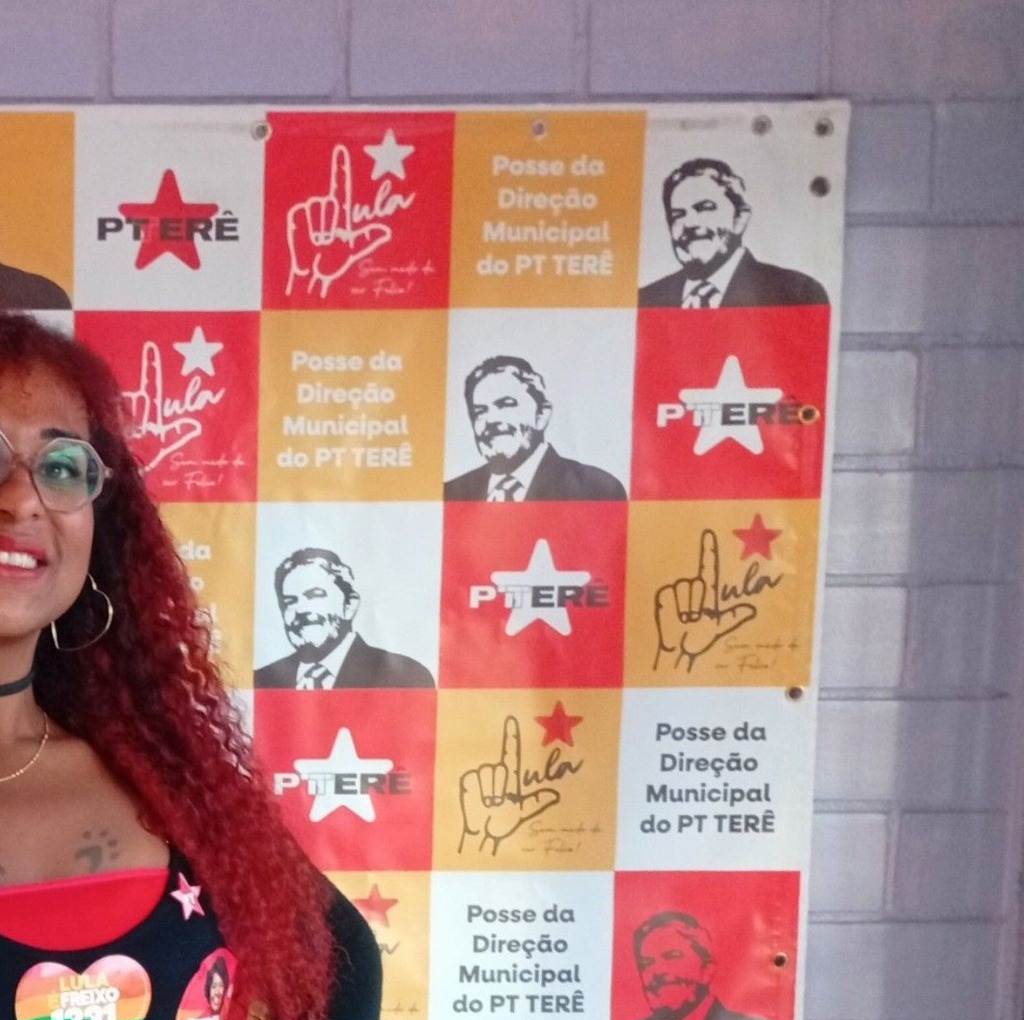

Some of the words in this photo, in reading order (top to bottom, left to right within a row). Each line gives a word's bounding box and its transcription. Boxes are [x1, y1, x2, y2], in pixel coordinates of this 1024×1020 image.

[491, 154, 566, 177] Posse
[569, 154, 606, 177] da
[497, 187, 599, 215] Direção
[482, 220, 610, 247] Municipal
[475, 255, 510, 277] do
[514, 253, 547, 275] PT
[552, 249, 614, 277] TERÊ
[291, 350, 365, 373] Posse
[368, 350, 404, 372] da
[296, 381, 396, 411] Direção
[283, 413, 409, 441] Municipal
[276, 447, 311, 469] do
[314, 447, 346, 469] PT
[349, 441, 413, 469] TERÊ
[655, 722, 727, 742] Posse
[733, 721, 767, 741] da
[660, 751, 759, 778] Direção
[646, 782, 771, 807] Municipal
[639, 814, 672, 834] do
[677, 814, 708, 833] PT
[713, 809, 775, 833] TERÊ
[467, 904, 537, 923] Posse
[542, 903, 575, 923] da
[473, 933, 569, 959] Direção
[59, 973, 109, 991] LULA
[459, 963, 581, 988] Municipal
[452, 994, 483, 1013] do
[489, 994, 520, 1013] PT
[525, 989, 585, 1013] TERÊ
